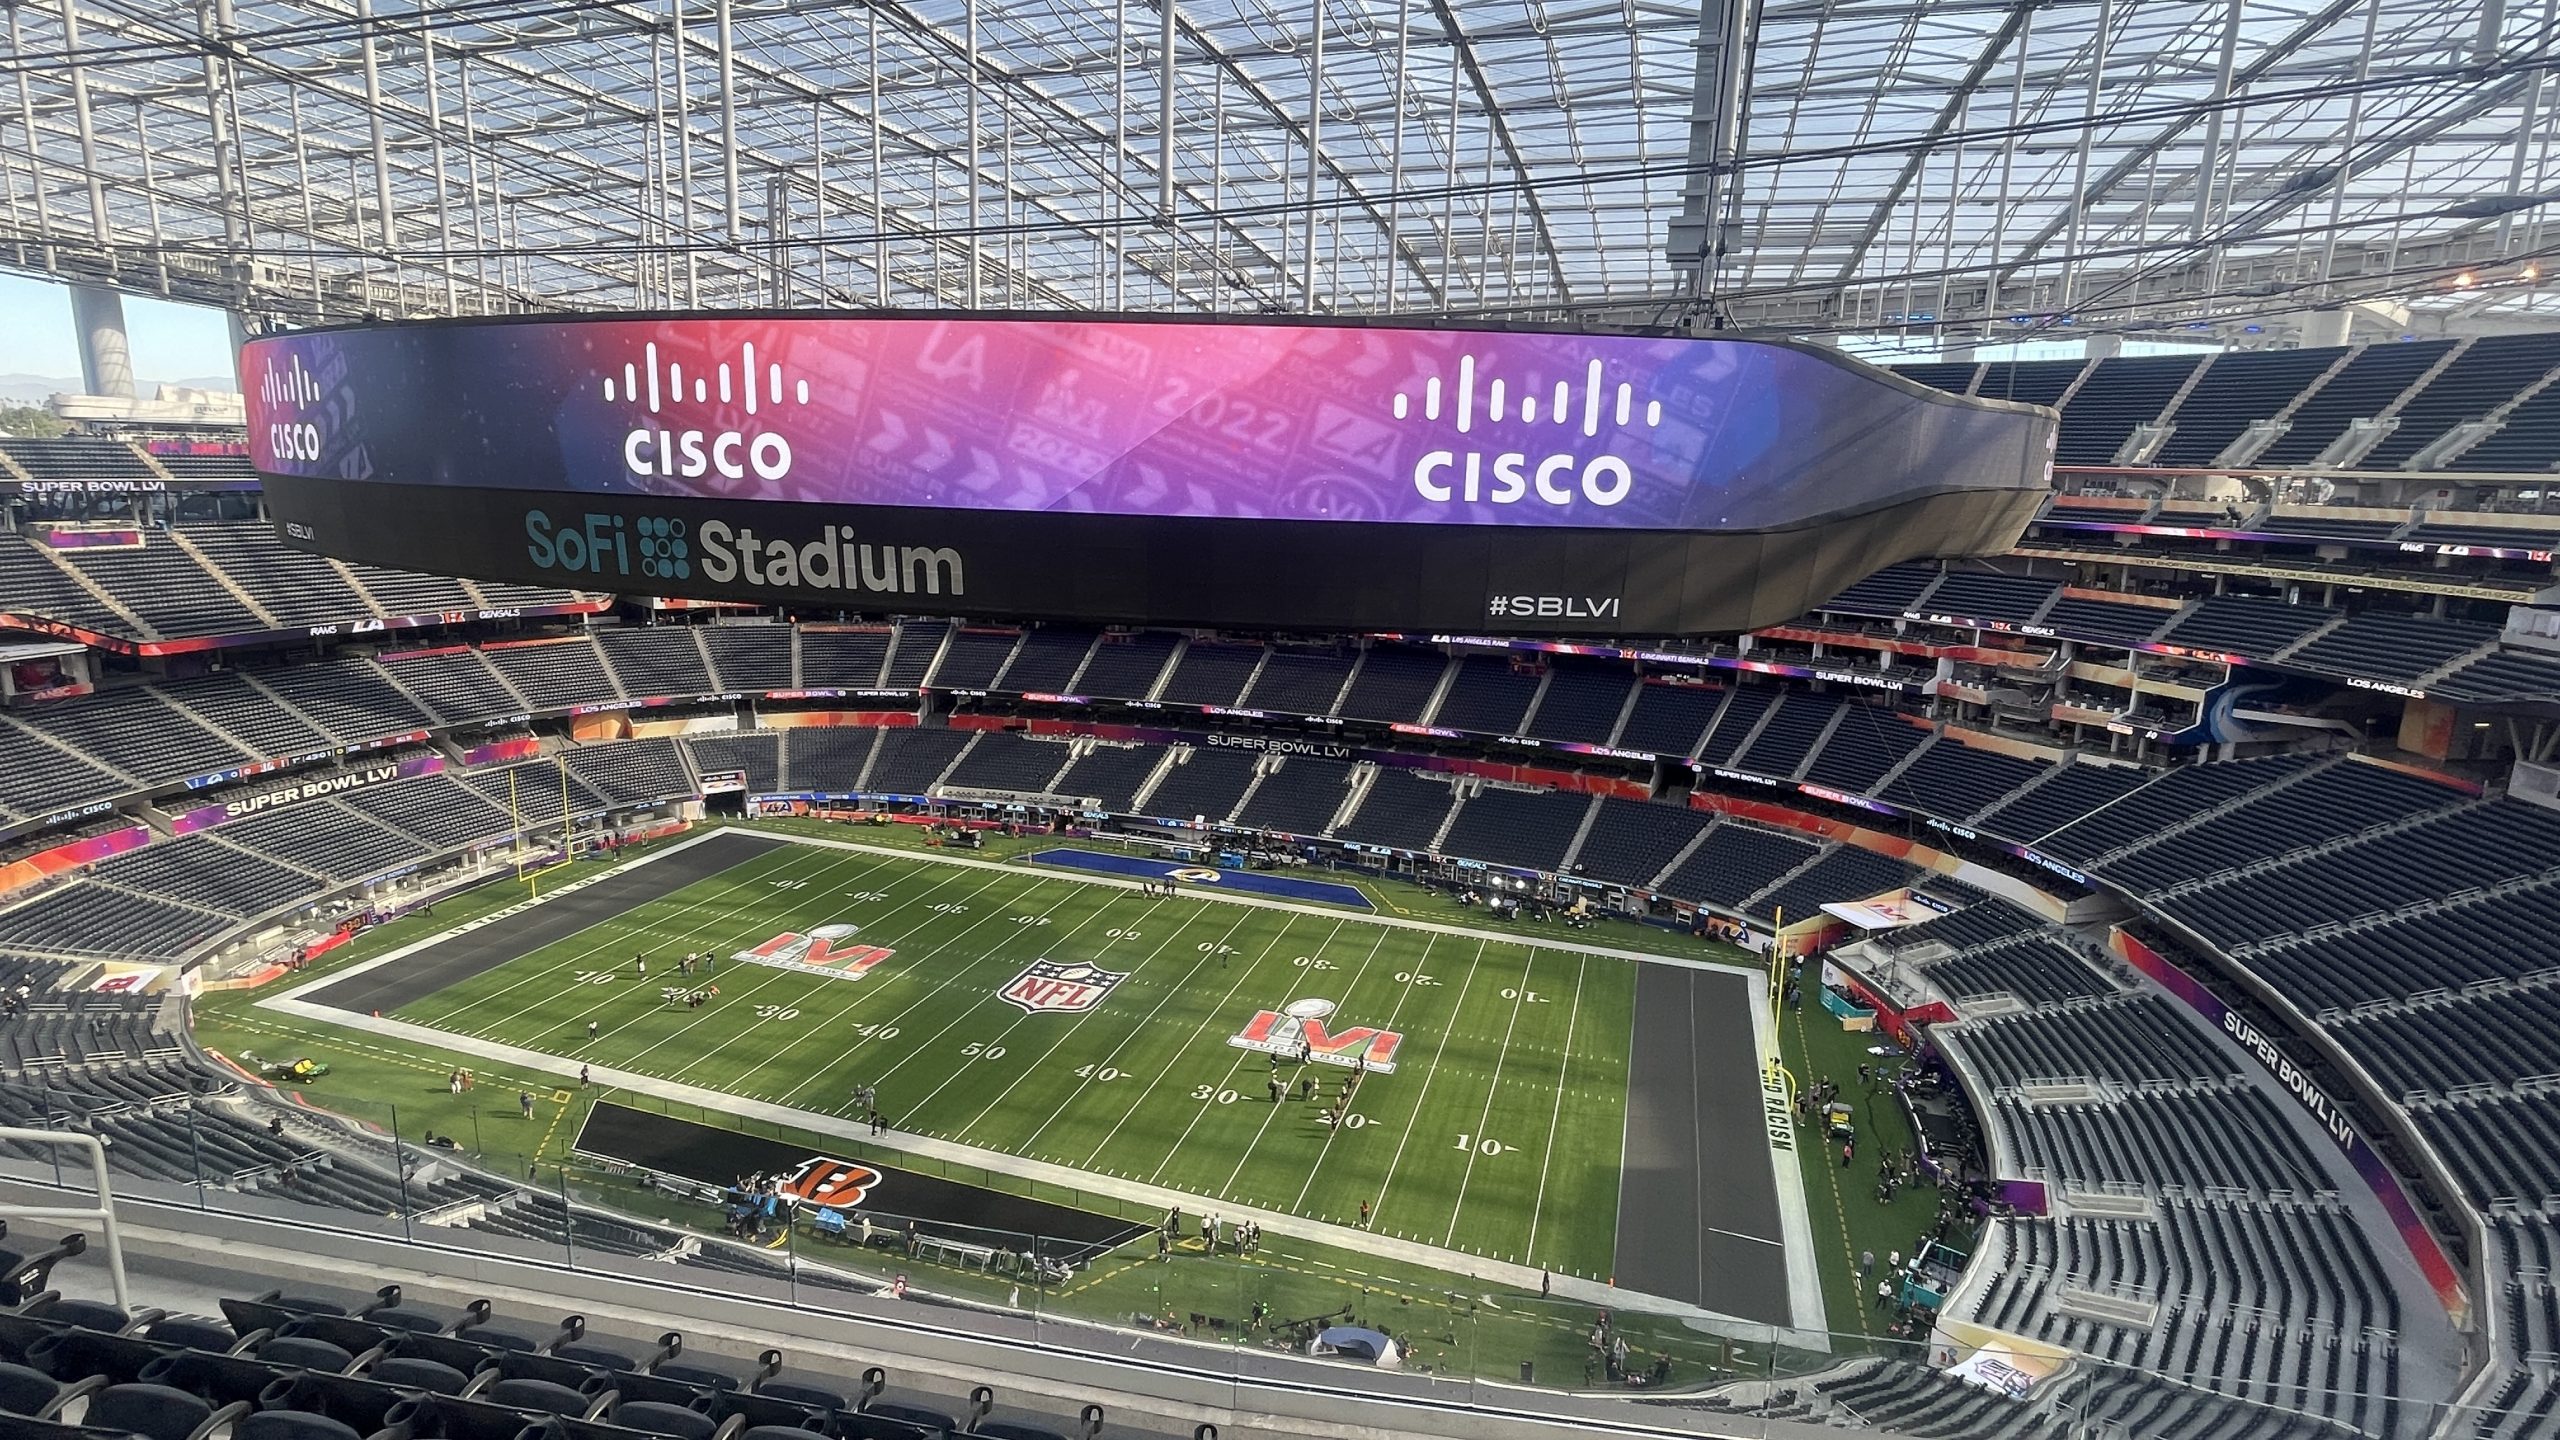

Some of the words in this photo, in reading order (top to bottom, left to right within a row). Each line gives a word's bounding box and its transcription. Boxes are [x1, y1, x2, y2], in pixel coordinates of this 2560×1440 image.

[271, 423, 319, 461] CISCO
[624, 429, 793, 480] CISCO
[1413, 450, 1632, 506] CISCO
[22, 482, 83, 492] SUPER
[88, 481, 140, 492] BOWL
[142, 481, 166, 491] LVI
[286, 522, 315, 541] #SBLVI
[524, 509, 630, 575] SoFi
[699, 518, 965, 595] Stadium
[2400, 542, 2424, 553] RAMS
[2271, 570, 2296, 578] YOUR
[1489, 595, 1619, 617] #SBLVI
[310, 625, 338, 636] RAMS
[2021, 625, 2055, 636] BENGALS
[1464, 637, 1492, 646] ANGELES
[1492, 639, 1510, 648] RAMS
[1640, 652, 1678, 663] CINCINNATI
[1678, 655, 1709, 666] BENGALS
[1815, 671, 1851, 683] SUPER
[1853, 676, 1884, 688] BOWL
[1884, 679, 1902, 691] LVI
[2347, 677, 2371, 689] LOS
[2371, 682, 2425, 700] ANGELES
[772, 691, 804, 699] SUPER
[805, 690, 833, 698] BOWL
[1027, 694, 1057, 702] SUPER
[1057, 695, 1081, 703] BOWL
[580, 704, 600, 714] LOS
[600, 701, 642, 712] ANGELES
[1210, 707, 1226, 715] LOS
[1226, 708, 1264, 718] ANGELES
[510, 714, 531, 723] CISCO
[1326, 717, 1343, 725] CISCO
[1396, 724, 1428, 735] SUPER
[1428, 727, 1456, 738] BOWL
[1207, 735, 1266, 750] SUPER
[1268, 740, 1321, 756] BOWL
[1324, 746, 1349, 758] LVI
[1521, 738, 1540, 747] CISCO
[1591, 747, 1610, 757] LOS
[1610, 749, 1656, 762] ANGELES
[1714, 769, 1740, 780] SUPER
[1741, 773, 1763, 784] BOWL
[226, 787, 300, 817] SUPER
[302, 773, 364, 798] BOWL
[367, 765, 398, 783] LVI
[1804, 786, 1840, 800] SUPER
[1841, 795, 1873, 809] BOWL
[83, 802, 113, 816] CISCO
[1952, 826, 1976, 840] CISCO
[1456, 859, 1488, 871] BENGALS
[2023, 850, 2042, 866] LOS
[2042, 859, 2086, 885] ANGELES
[542, 888, 573, 902] ALL
[1931, 900, 1949, 912] CISCO
[1010, 976, 1096, 1007] NFL
[1500, 987, 1539, 1003] 10
[757, 1004, 800, 1021] 30
[858, 1023, 900, 1040] 40
[960, 1042, 1007, 1061] 50
[1246, 1041, 1304, 1056] SUPE
[1074, 1063, 1120, 1082] 40
[2223, 1011, 2278, 1069] SUPER
[2278, 1060, 2329, 1121] BOWL
[2329, 1118, 2355, 1150] LVI
[1190, 1084, 1240, 1105] 30
[1765, 1097, 1793, 1152] RACISM
[1453, 1133, 1502, 1157] 10
